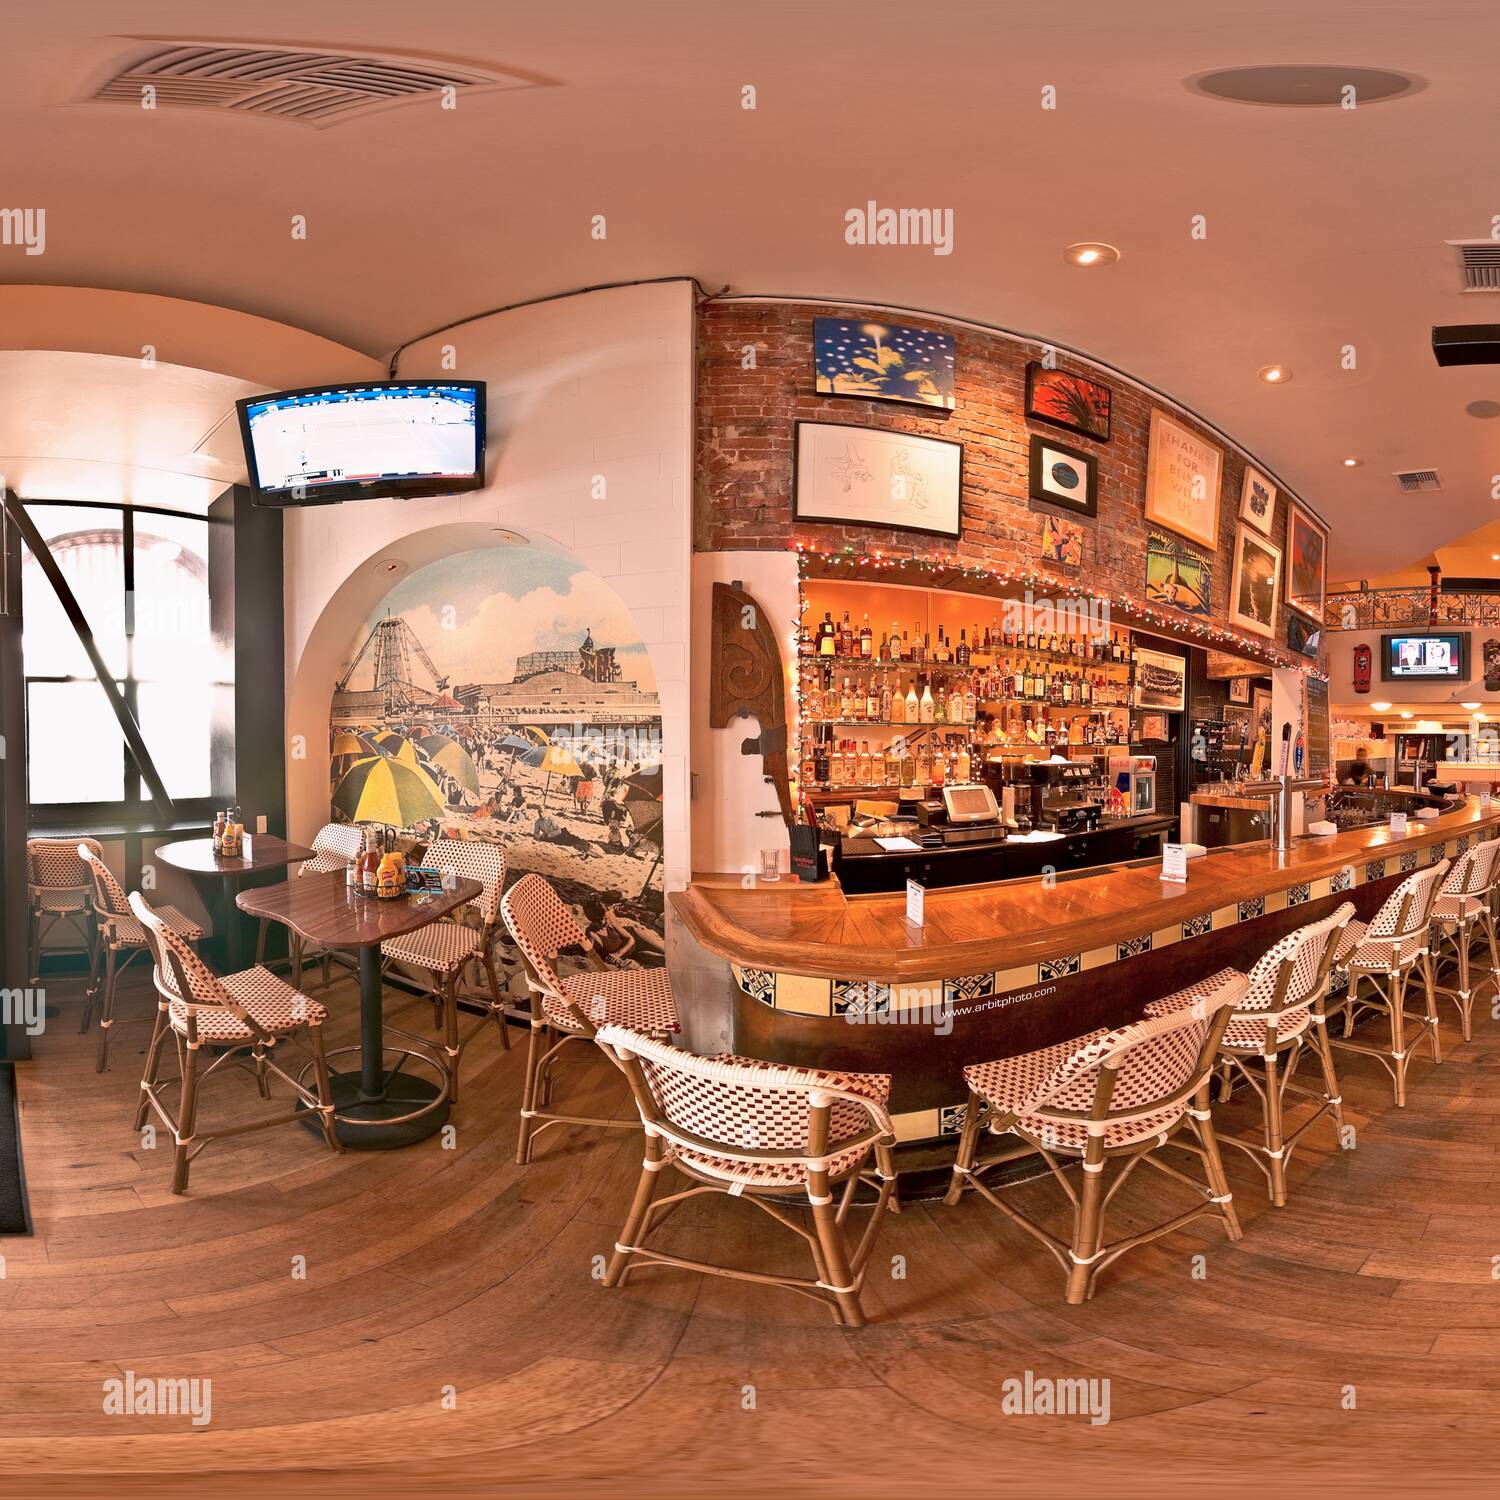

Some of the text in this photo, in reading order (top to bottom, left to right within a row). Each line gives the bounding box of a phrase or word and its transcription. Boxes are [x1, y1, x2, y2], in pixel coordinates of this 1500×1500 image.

[1166, 433, 1211, 466] THANKS
[1177, 453, 1198, 473] FOR
[1178, 500, 1193, 513] US
